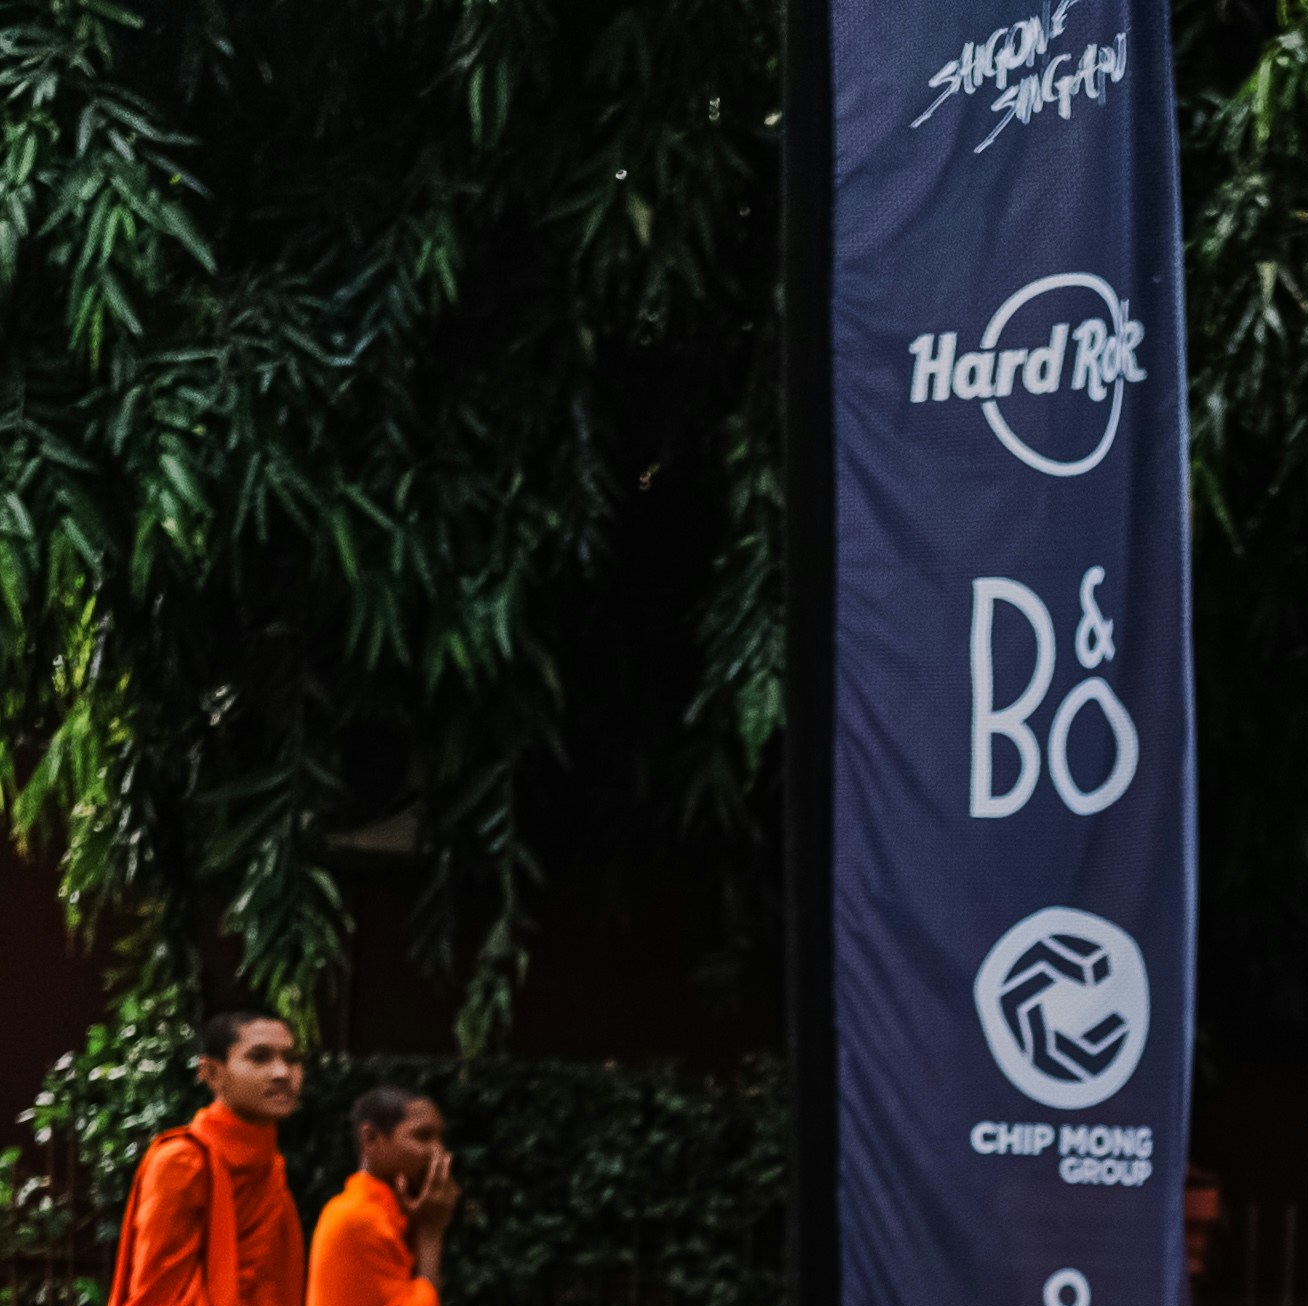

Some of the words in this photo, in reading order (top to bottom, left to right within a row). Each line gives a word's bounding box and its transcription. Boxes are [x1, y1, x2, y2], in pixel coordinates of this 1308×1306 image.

[909, 323, 1070, 402] Hard
[970, 1121, 1055, 1155] CHIP
[1059, 1125, 1153, 1159] MONG
[1059, 1158, 1153, 1187] GROUP
